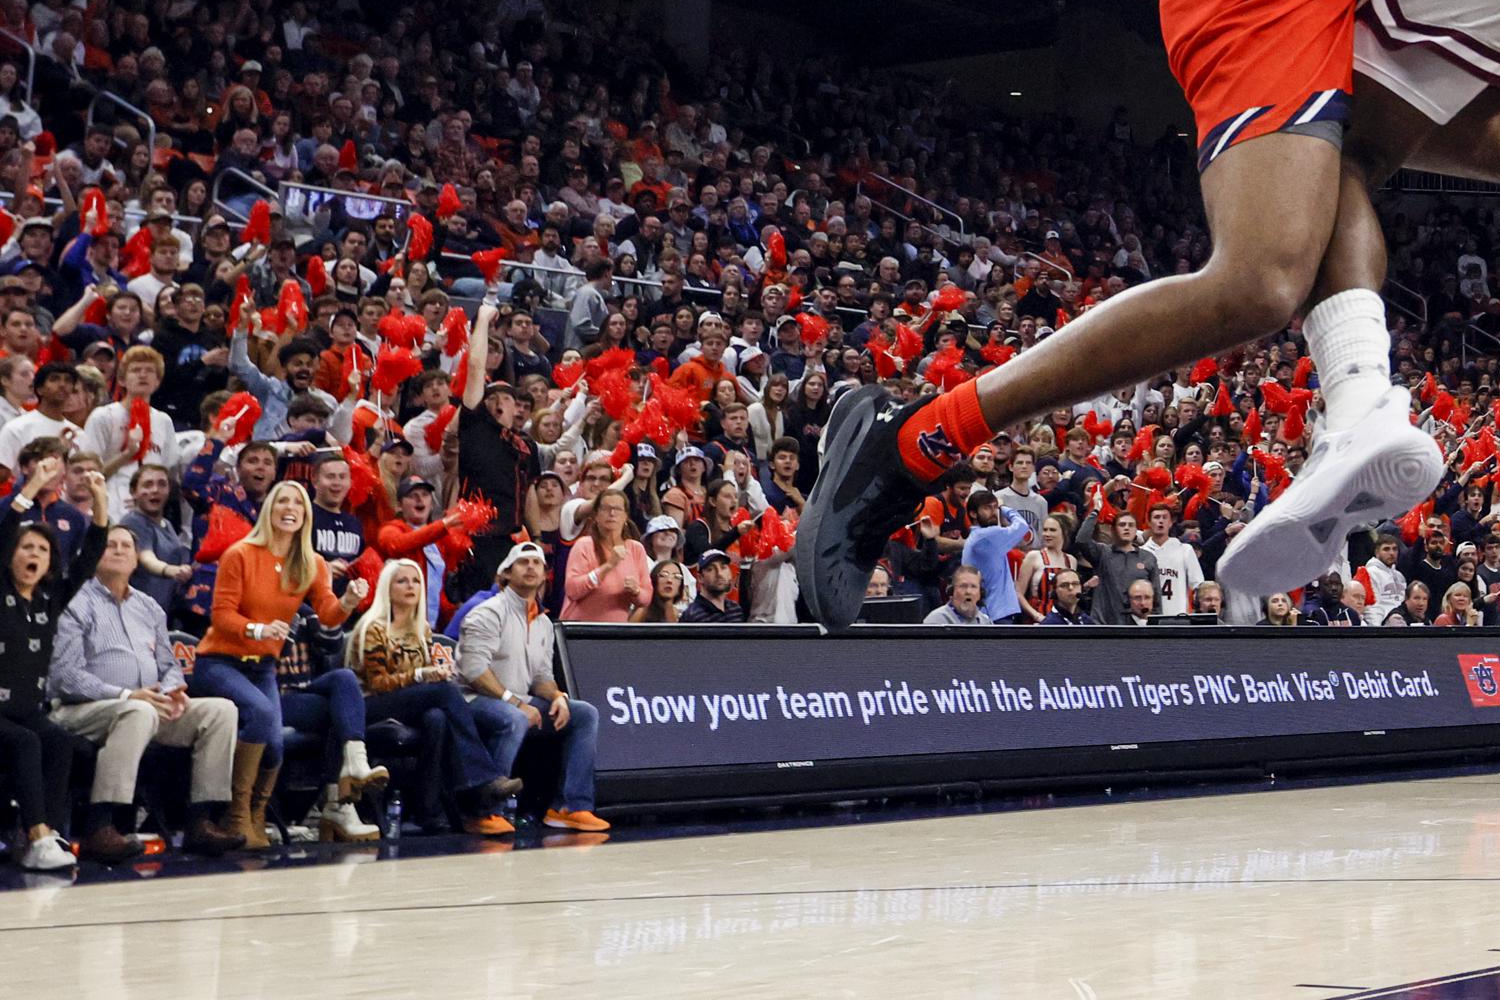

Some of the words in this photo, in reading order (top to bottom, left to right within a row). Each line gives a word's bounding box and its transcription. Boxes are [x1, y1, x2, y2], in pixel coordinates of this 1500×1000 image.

[316, 529, 336, 552] NO
[337, 531, 361, 553] QUIT
[1161, 578, 1173, 601] 4
[606, 686, 696, 725] Show
[701, 691, 771, 730] your
[776, 685, 853, 719] team
[858, 679, 929, 726] pride
[931, 678, 988, 714] with
[991, 679, 1033, 712] the
[1039, 677, 1124, 711] Auburn
[1122, 674, 1194, 715] Tigers
[1193, 674, 1241, 705] PNC
[1243, 672, 1295, 704] Bank
[1341, 670, 1390, 700] Debit
[1391, 670, 1440, 698] Card.
